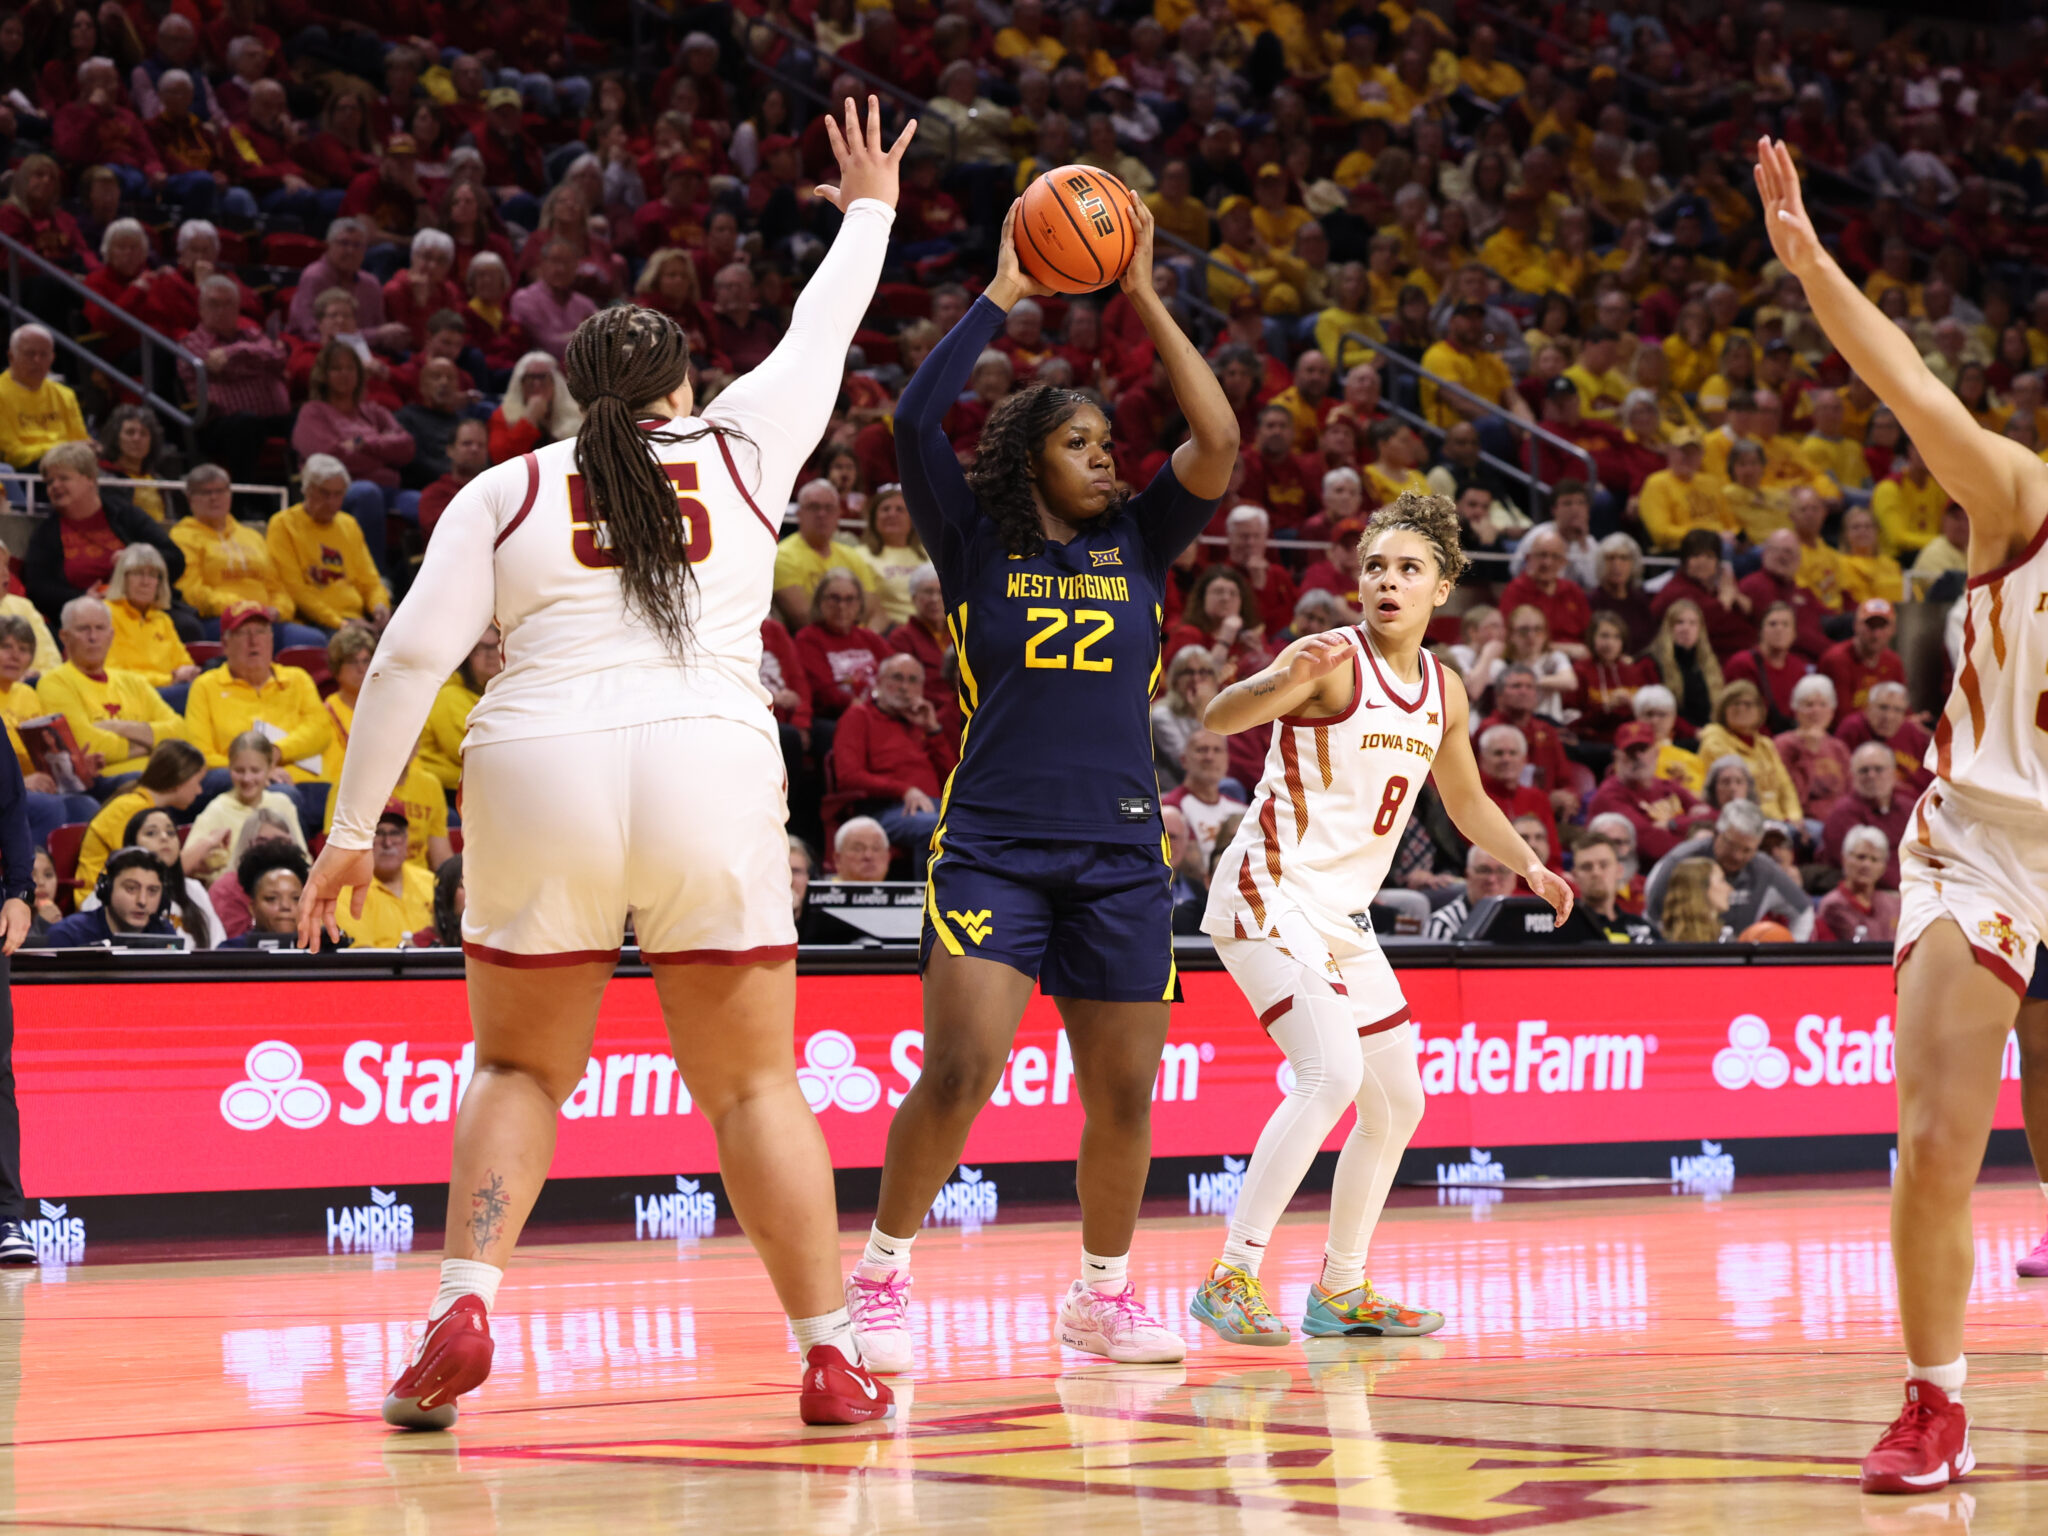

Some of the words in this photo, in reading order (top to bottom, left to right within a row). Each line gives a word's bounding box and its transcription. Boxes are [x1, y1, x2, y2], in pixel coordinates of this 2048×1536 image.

[1066, 175, 1115, 237] ELITE
[1006, 572, 1054, 598] WEST
[1057, 573, 1130, 602] VIRGINIA
[1025, 607, 1115, 673] 22
[1359, 733, 1403, 751] IOWA
[1406, 737, 1435, 763] STAT
[1373, 775, 1409, 836] 8
[1436, 1161, 1505, 1184] LANDUS
[1670, 1153, 1735, 1179] LANDUS
[634, 1191, 716, 1217] LANDUS
[931, 1180, 998, 1205] ANDUS
[20, 1217, 86, 1242] NDUS
[326, 1203, 414, 1231] LANDUS
